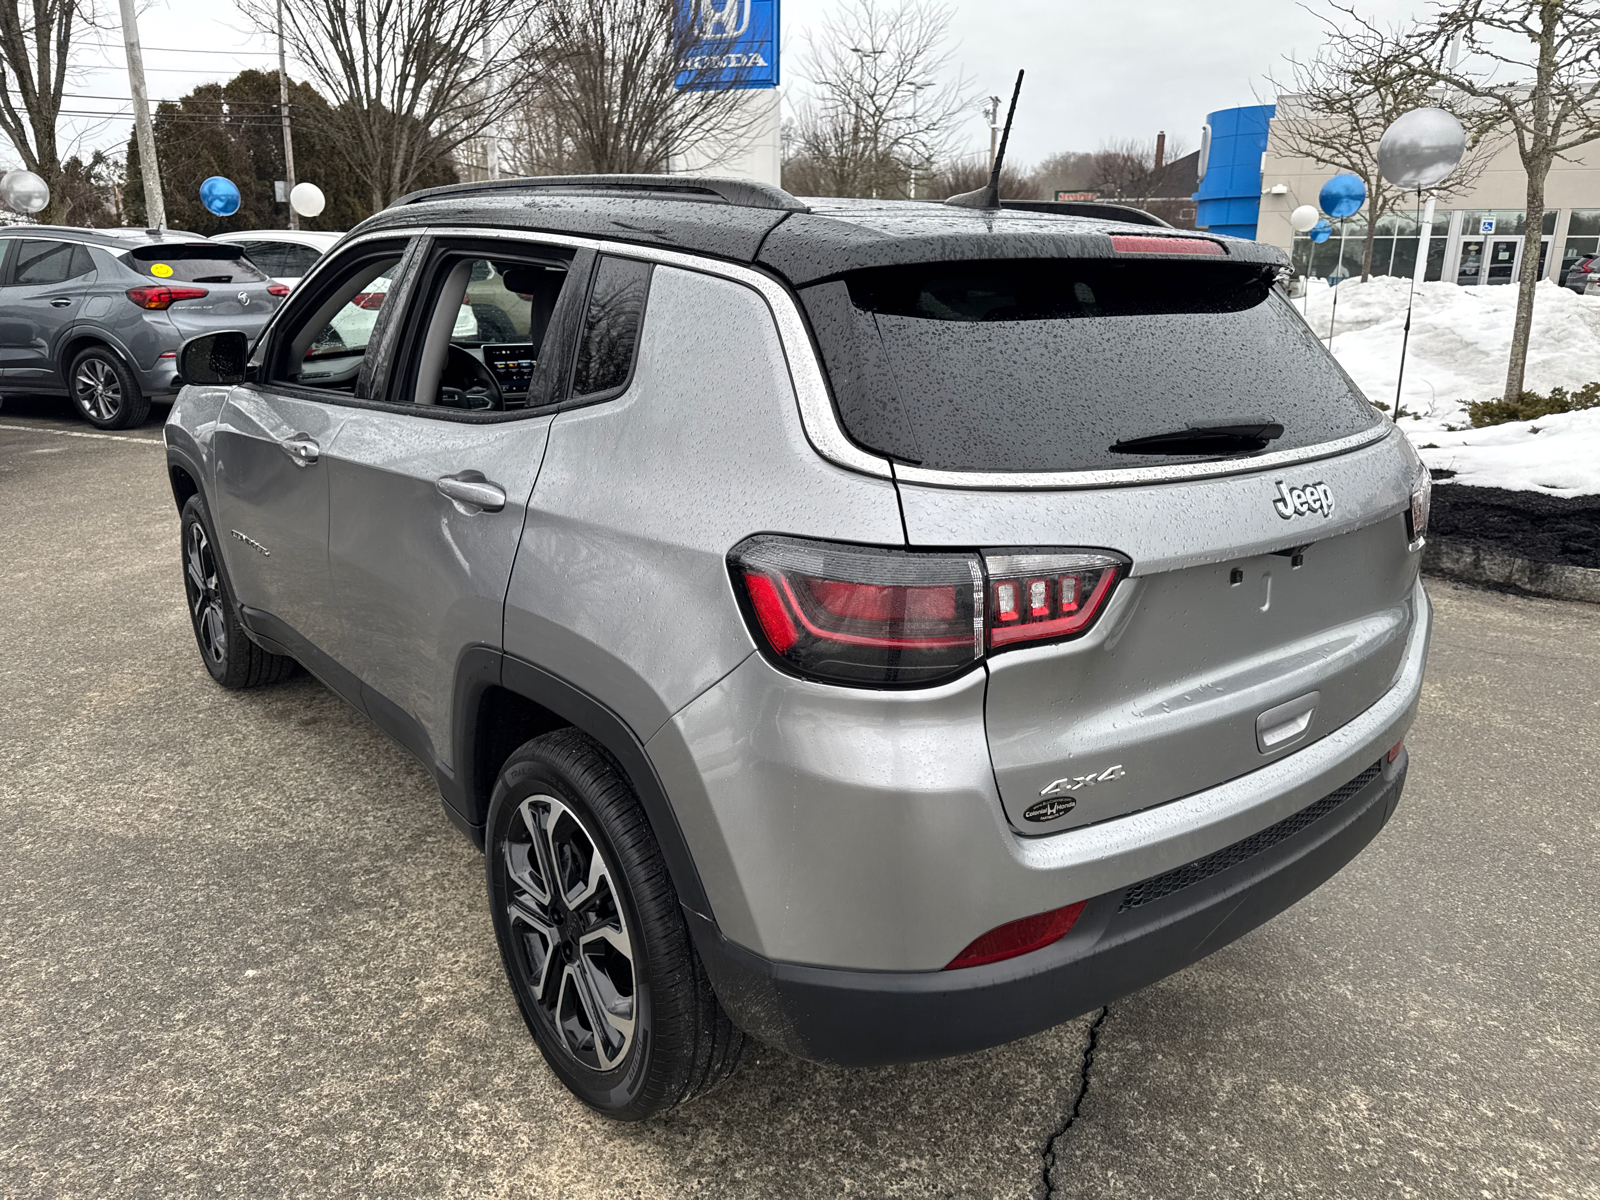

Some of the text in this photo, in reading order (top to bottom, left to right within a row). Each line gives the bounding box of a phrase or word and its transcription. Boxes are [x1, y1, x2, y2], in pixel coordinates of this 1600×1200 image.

[1272, 480, 1335, 520] Jeep
[1025, 807, 1048, 818] Colonial
[1056, 801, 1076, 811] Honda
